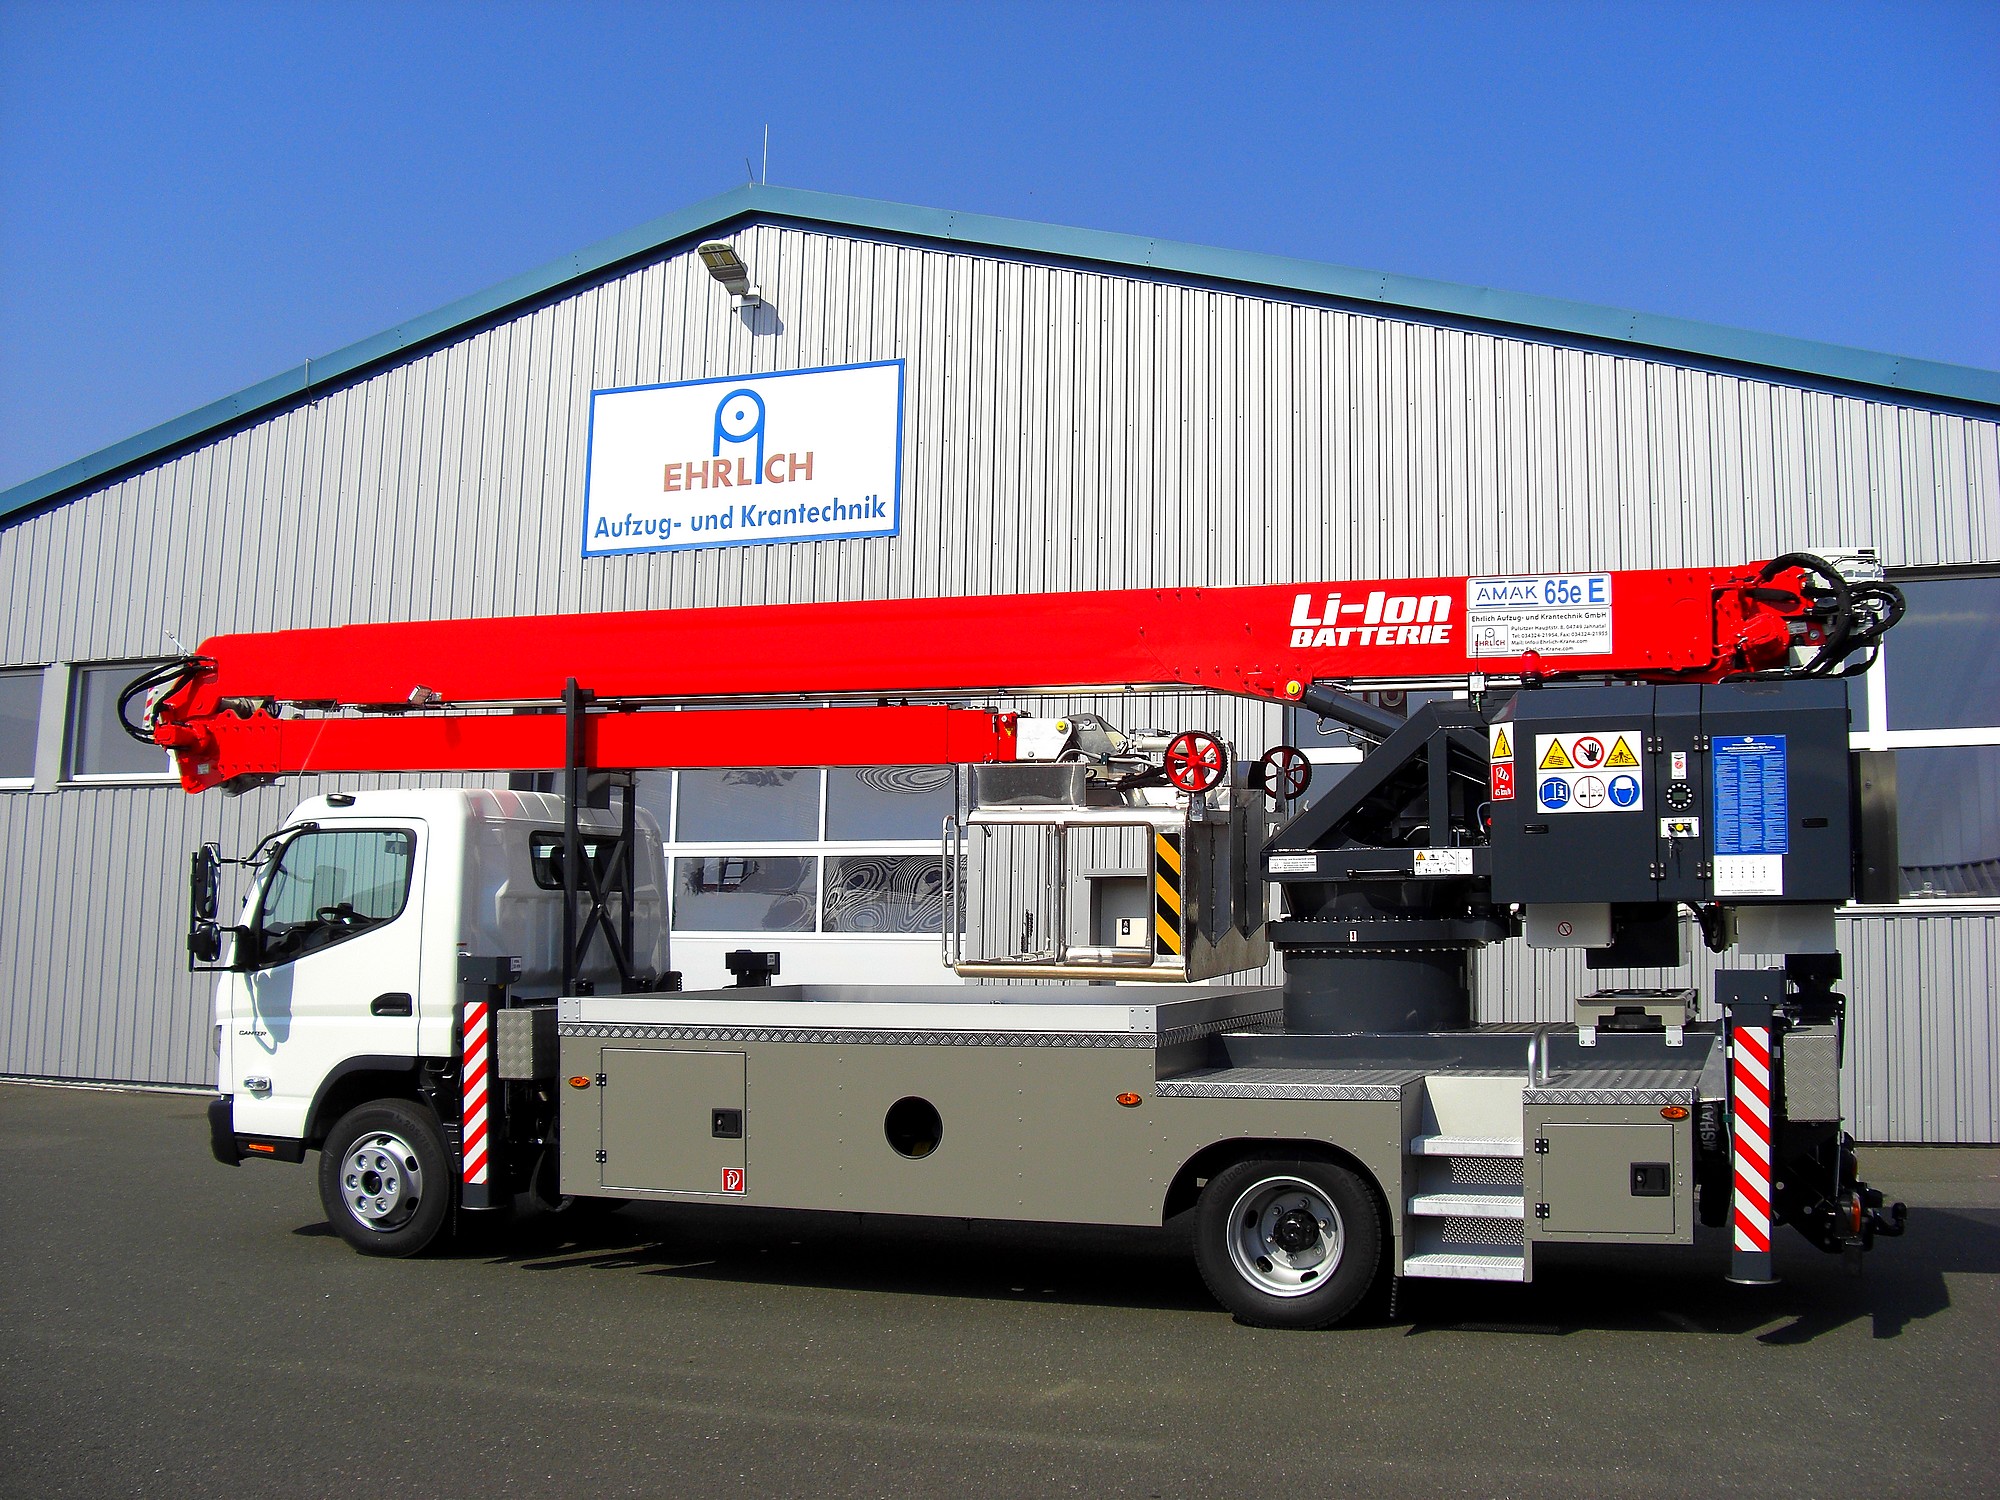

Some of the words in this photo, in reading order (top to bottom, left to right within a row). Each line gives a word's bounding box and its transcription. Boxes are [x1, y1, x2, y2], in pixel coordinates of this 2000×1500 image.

[663, 451, 814, 492] EHRLICH
[594, 513, 682, 540] Aufzug-
[690, 505, 734, 532] und
[741, 494, 887, 528] Krantechnik
[1476, 585, 1538, 601] AMAK
[1544, 579, 1582, 605] 65e
[1588, 577, 1605, 603] E
[1289, 591, 1452, 627] Li-Ion
[1471, 615, 1496, 623] Ehrlich
[1496, 614, 1525, 623] Aufzug-
[1525, 613, 1540, 621] und
[1540, 612, 1583, 620] Krantechnik
[1289, 625, 1453, 648] BATTERIE
